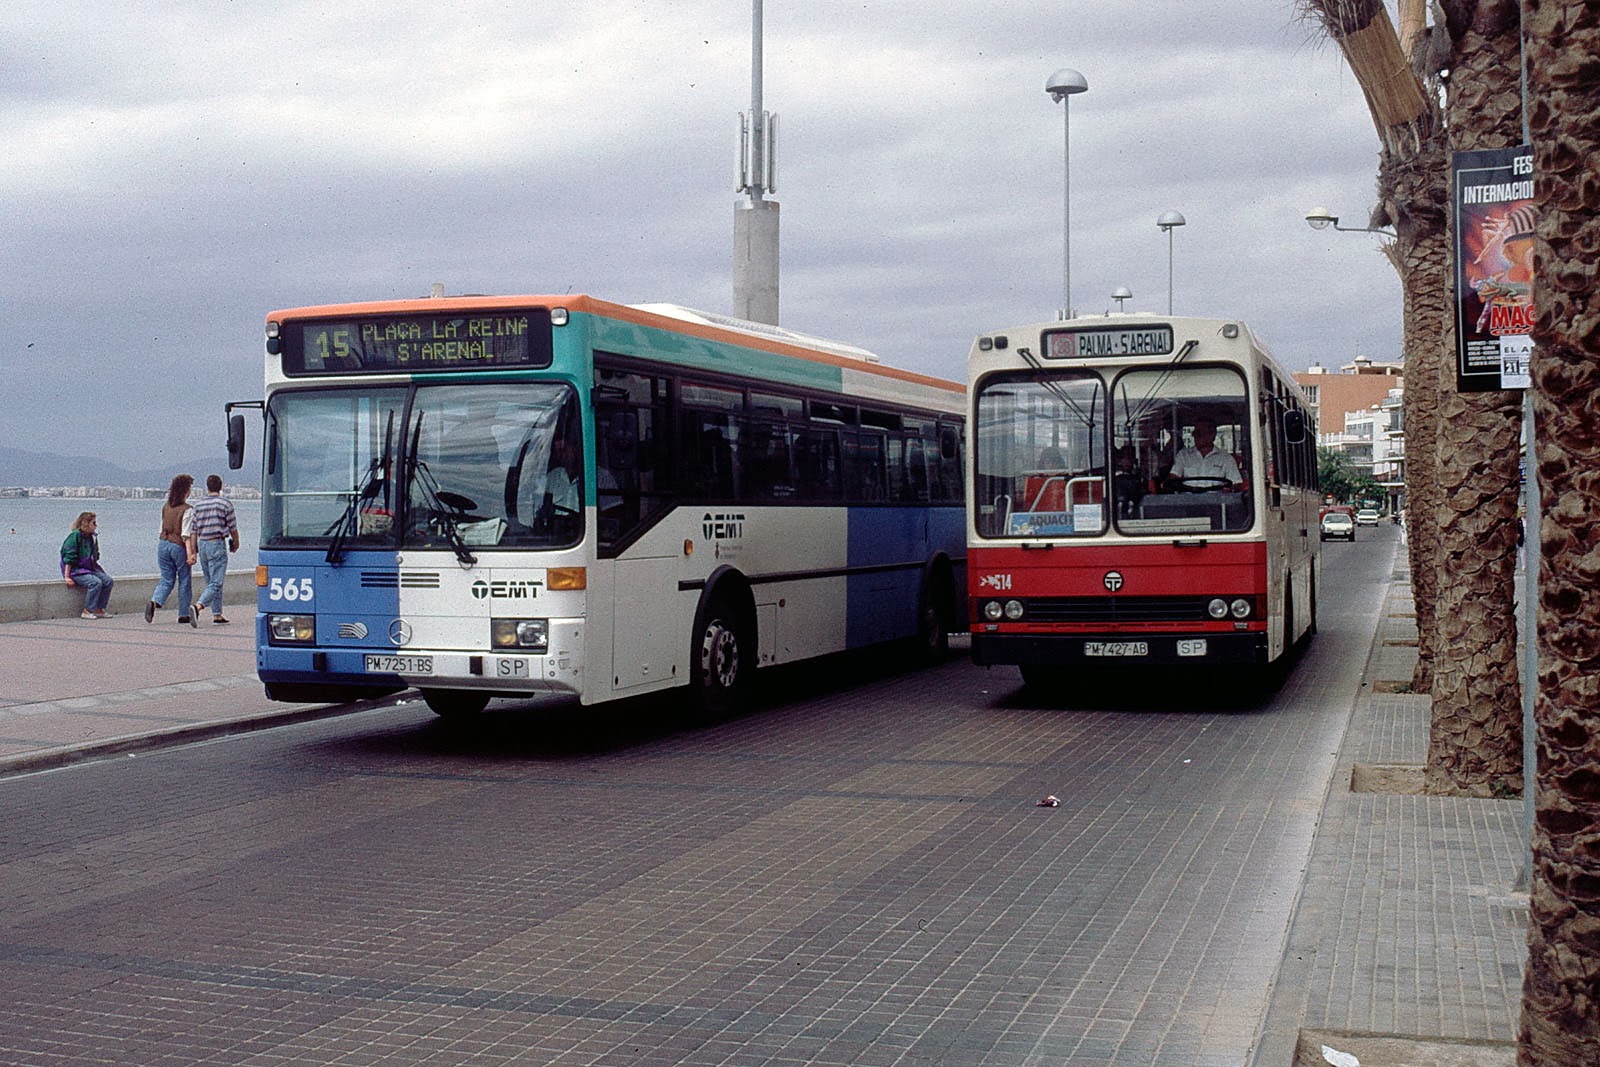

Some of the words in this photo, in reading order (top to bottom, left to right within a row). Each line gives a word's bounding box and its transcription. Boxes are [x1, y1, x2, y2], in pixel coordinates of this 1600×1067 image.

[1513, 155, 1534, 175] FES
[362, 322, 421, 342] PLAÇA
[432, 319, 457, 338] LA
[469, 317, 528, 336] REINA
[316, 331, 349, 358] 15
[398, 340, 494, 361] S'ARENAL
[1079, 335, 1113, 356] PALMA
[1120, 332, 1169, 353] S'ARENAL
[715, 514, 745, 538] EMT
[269, 578, 314, 601] 565
[490, 581, 543, 598] EMT
[1181, 642, 1203, 654] SP
[366, 658, 432, 673] PM-7251-BS
[500, 660, 524, 676] SP
